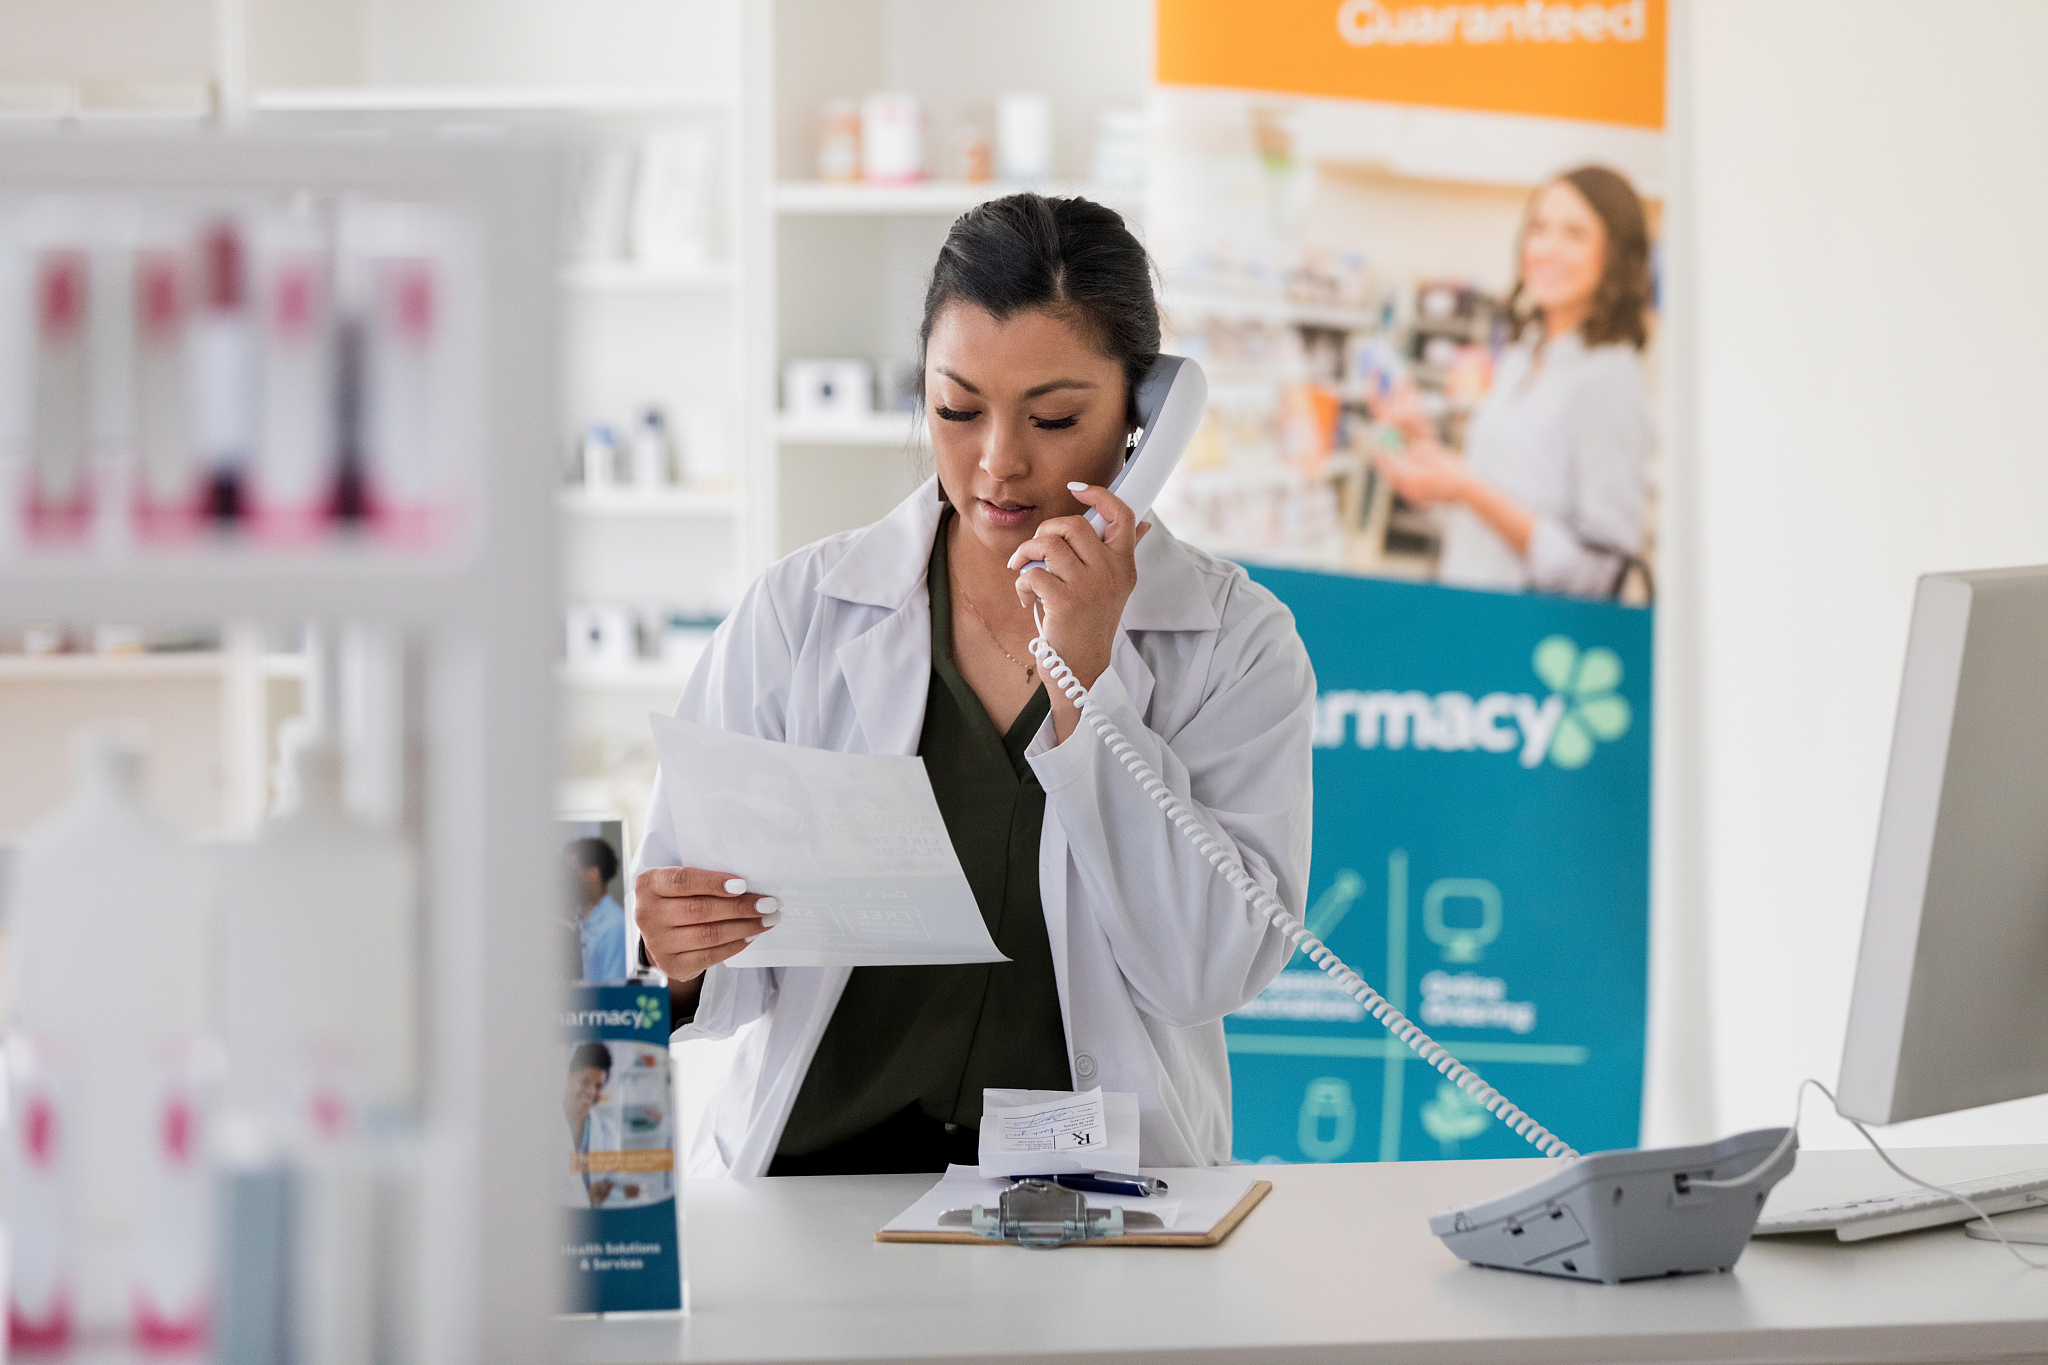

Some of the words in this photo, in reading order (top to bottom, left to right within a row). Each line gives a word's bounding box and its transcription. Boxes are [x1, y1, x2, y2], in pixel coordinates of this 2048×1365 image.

[1337, 0, 1647, 45] Guaranteed
[605, 1241, 662, 1255] Solutions
[593, 1257, 645, 1271] Services
